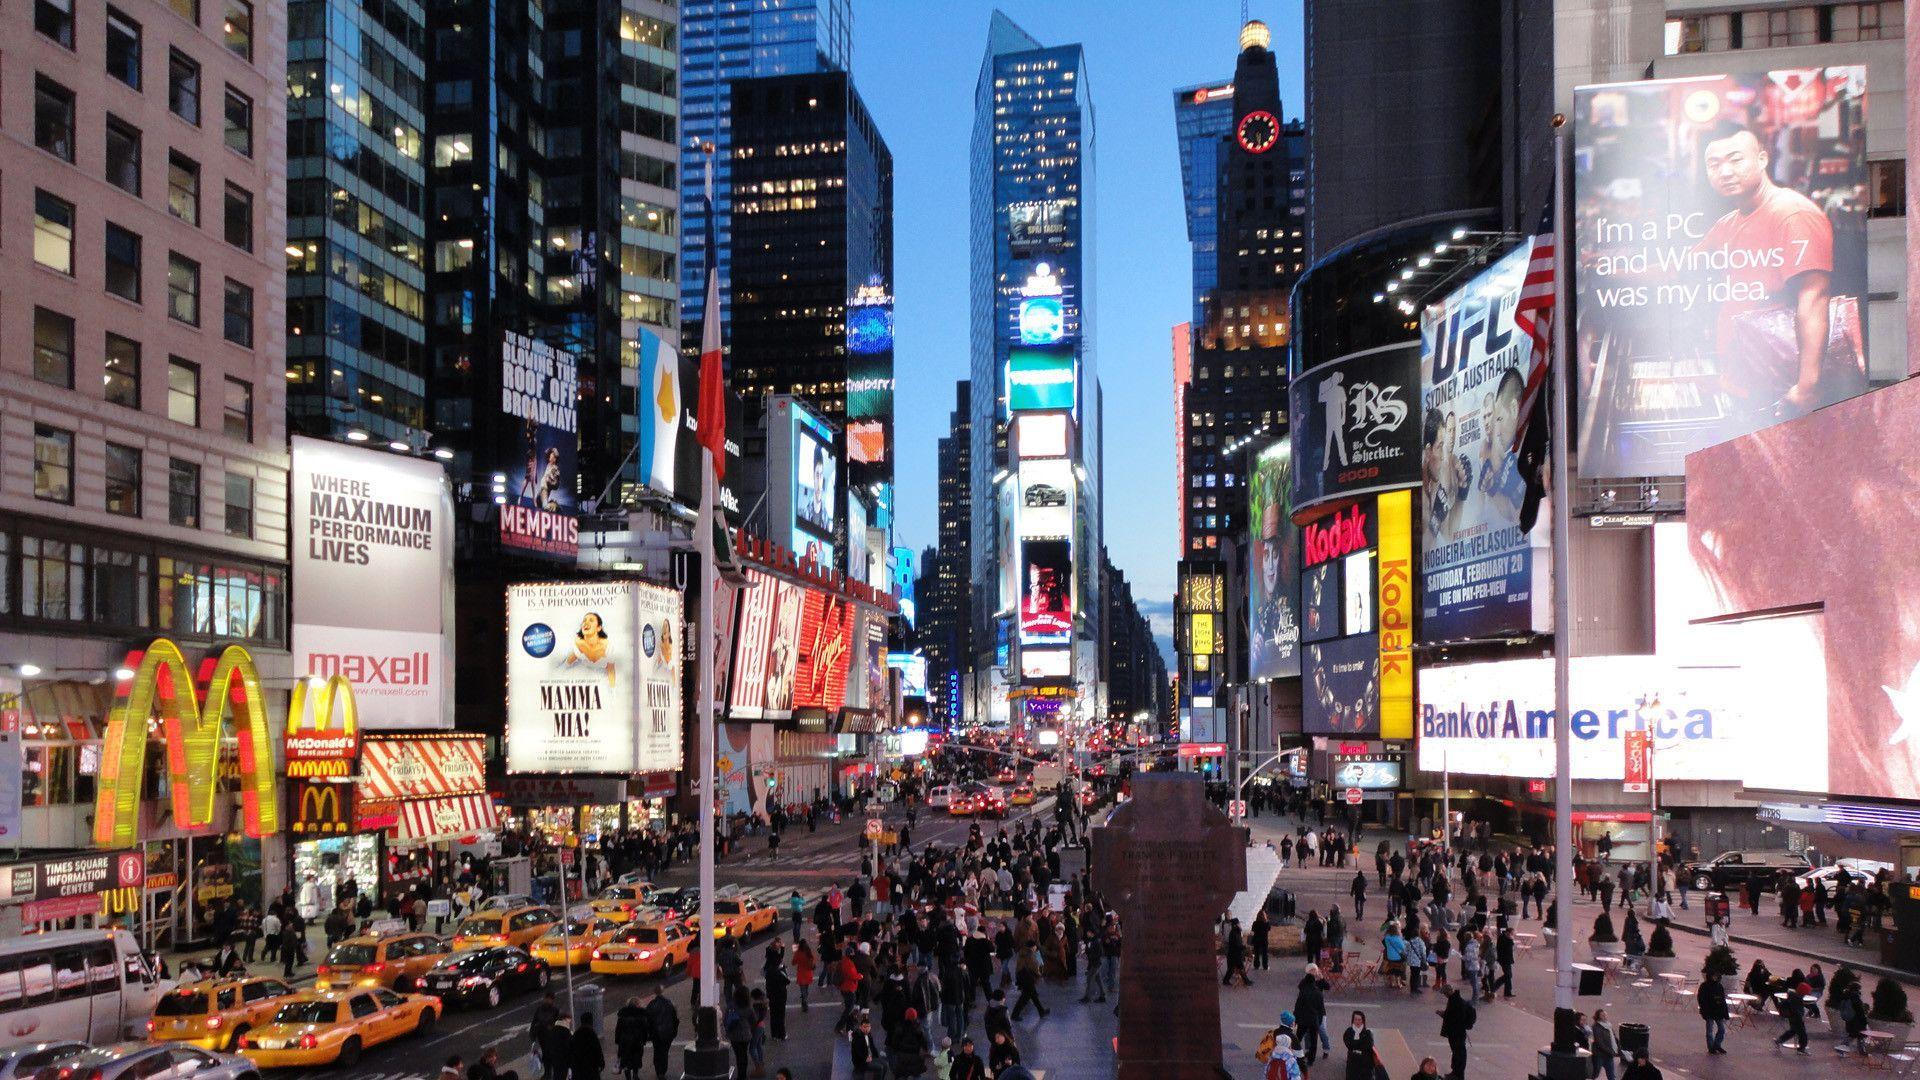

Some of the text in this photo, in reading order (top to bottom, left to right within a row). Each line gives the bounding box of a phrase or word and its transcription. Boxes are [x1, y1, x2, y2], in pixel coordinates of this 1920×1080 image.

[1596, 212, 1704, 243] I'm a PC
[1596, 240, 1810, 276] and Windows 7
[1596, 276, 1770, 311] was my idea.
[502, 341, 577, 384] BLOWING THE
[502, 361, 577, 409] ROOF OFF
[1425, 344, 1520, 413] SYDNEY, AUSTRALIA
[502, 387, 577, 434] BROADWAY!
[310, 472, 371, 498] WHERE
[310, 491, 432, 533] MAXIMUM
[501, 503, 579, 545] MEMPHIS
[309, 518, 432, 550] PERFORMANCE
[1305, 503, 1368, 567] Kodak
[309, 538, 370, 566] LIVES
[1424, 540, 1465, 571] NOGUEIRA
[1427, 553, 1523, 593] SATURDAY, FEBRUARY 20
[527, 598, 536, 608] IS
[538, 598, 545, 607] A
[591, 585, 630, 596] MUSICAL
[1440, 579, 1507, 607] LIVE ON PAY-PER-VIEW
[1381, 559, 1409, 676] Kodak
[308, 652, 429, 686] maxell
[353, 687, 429, 697] ww.maxell.com
[540, 685, 602, 711] MAMMA
[646, 683, 671, 708] MAMMA
[553, 712, 590, 738] MIA!
[652, 709, 667, 733] MIA!
[1423, 698, 1713, 740] Bank of America
[286, 737, 355, 749] McDonald's
[297, 749, 343, 757] Restaurant
[1334, 754, 1401, 762] MARQUIS
[45, 856, 109, 875] TIMES SQUARE
[47, 869, 107, 887] INFORMATION
[60, 881, 94, 896] CENTER
